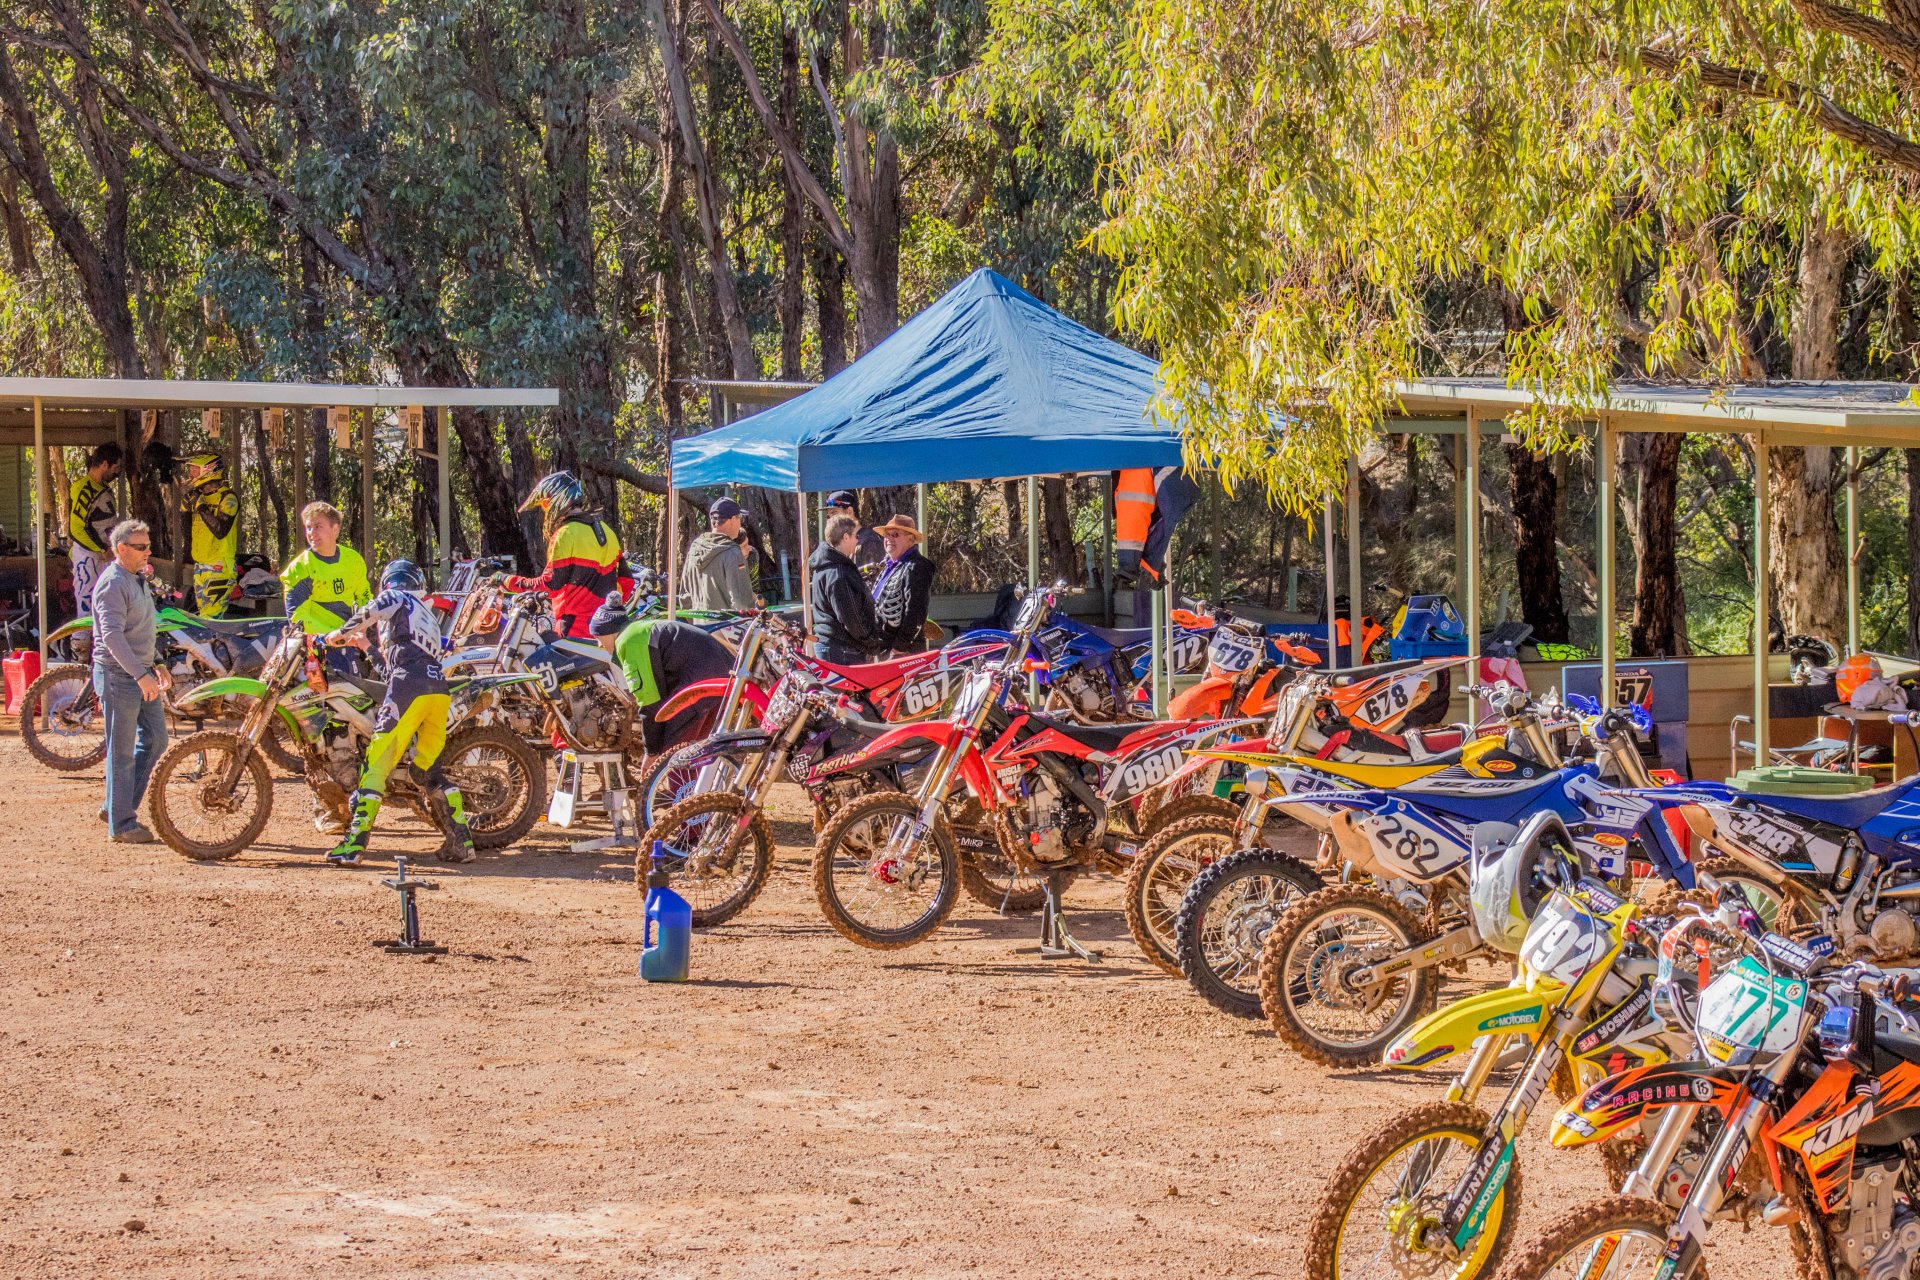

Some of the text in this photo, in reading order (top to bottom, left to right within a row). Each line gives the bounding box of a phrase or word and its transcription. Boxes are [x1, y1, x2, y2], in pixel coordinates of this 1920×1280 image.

[73, 481, 99, 520] FOX
[898, 657, 926, 669] HONDA
[1213, 642, 1255, 671] 678
[905, 670, 950, 715] 657
[1364, 684, 1409, 723] 678
[1139, 723, 1164, 735] HONDA
[1198, 719, 1241, 733] DUNLOP
[1477, 727, 1507, 737] HOND
[789, 760, 809, 771] FAST
[996, 764, 1021, 778] MUSCLE
[1123, 746, 1183, 795] 980
[1235, 753, 1279, 764] DUNLOP
[1001, 775, 1018, 787] MILK
[1304, 791, 1367, 801] DUNLOP
[1681, 793, 1717, 803] DUNLOP
[1375, 815, 1440, 876] 282
[1729, 812, 1796, 855] 348
[1519, 907, 1607, 983] 792
[1499, 1014, 1536, 1026] MOTOREX
[1597, 989, 1652, 1039] YOSHIMURA
[1612, 1084, 1691, 1108] RACING
[1558, 1111, 1598, 1139] KTM
[1801, 1100, 1874, 1159] KTM
[1453, 1136, 1502, 1222] DUNLOP
[1475, 1159, 1511, 1213] MOTOREX
